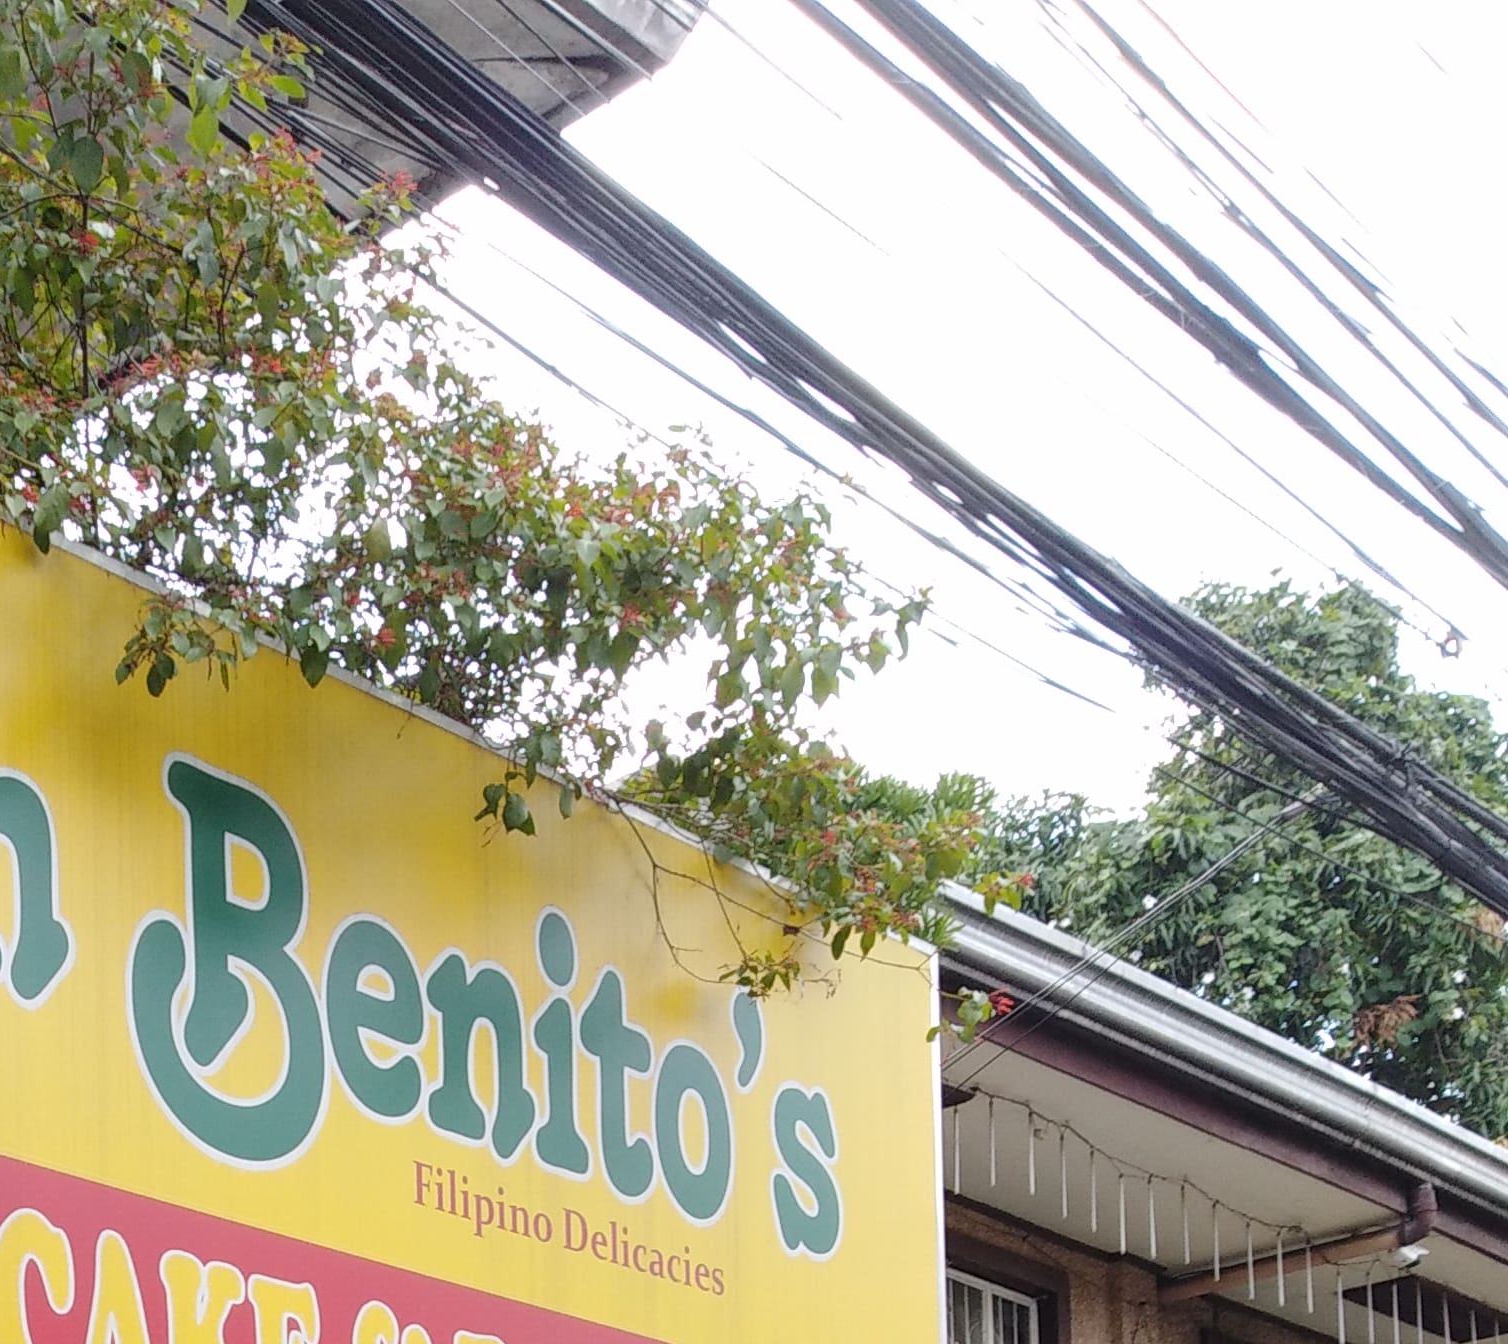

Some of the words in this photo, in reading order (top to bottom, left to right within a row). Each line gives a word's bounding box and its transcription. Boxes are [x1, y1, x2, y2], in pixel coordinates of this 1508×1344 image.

[126, 751, 843, 1261] Benito's
[413, 1160, 553, 1239] Filipino
[563, 1208, 725, 1296] Delicacies
